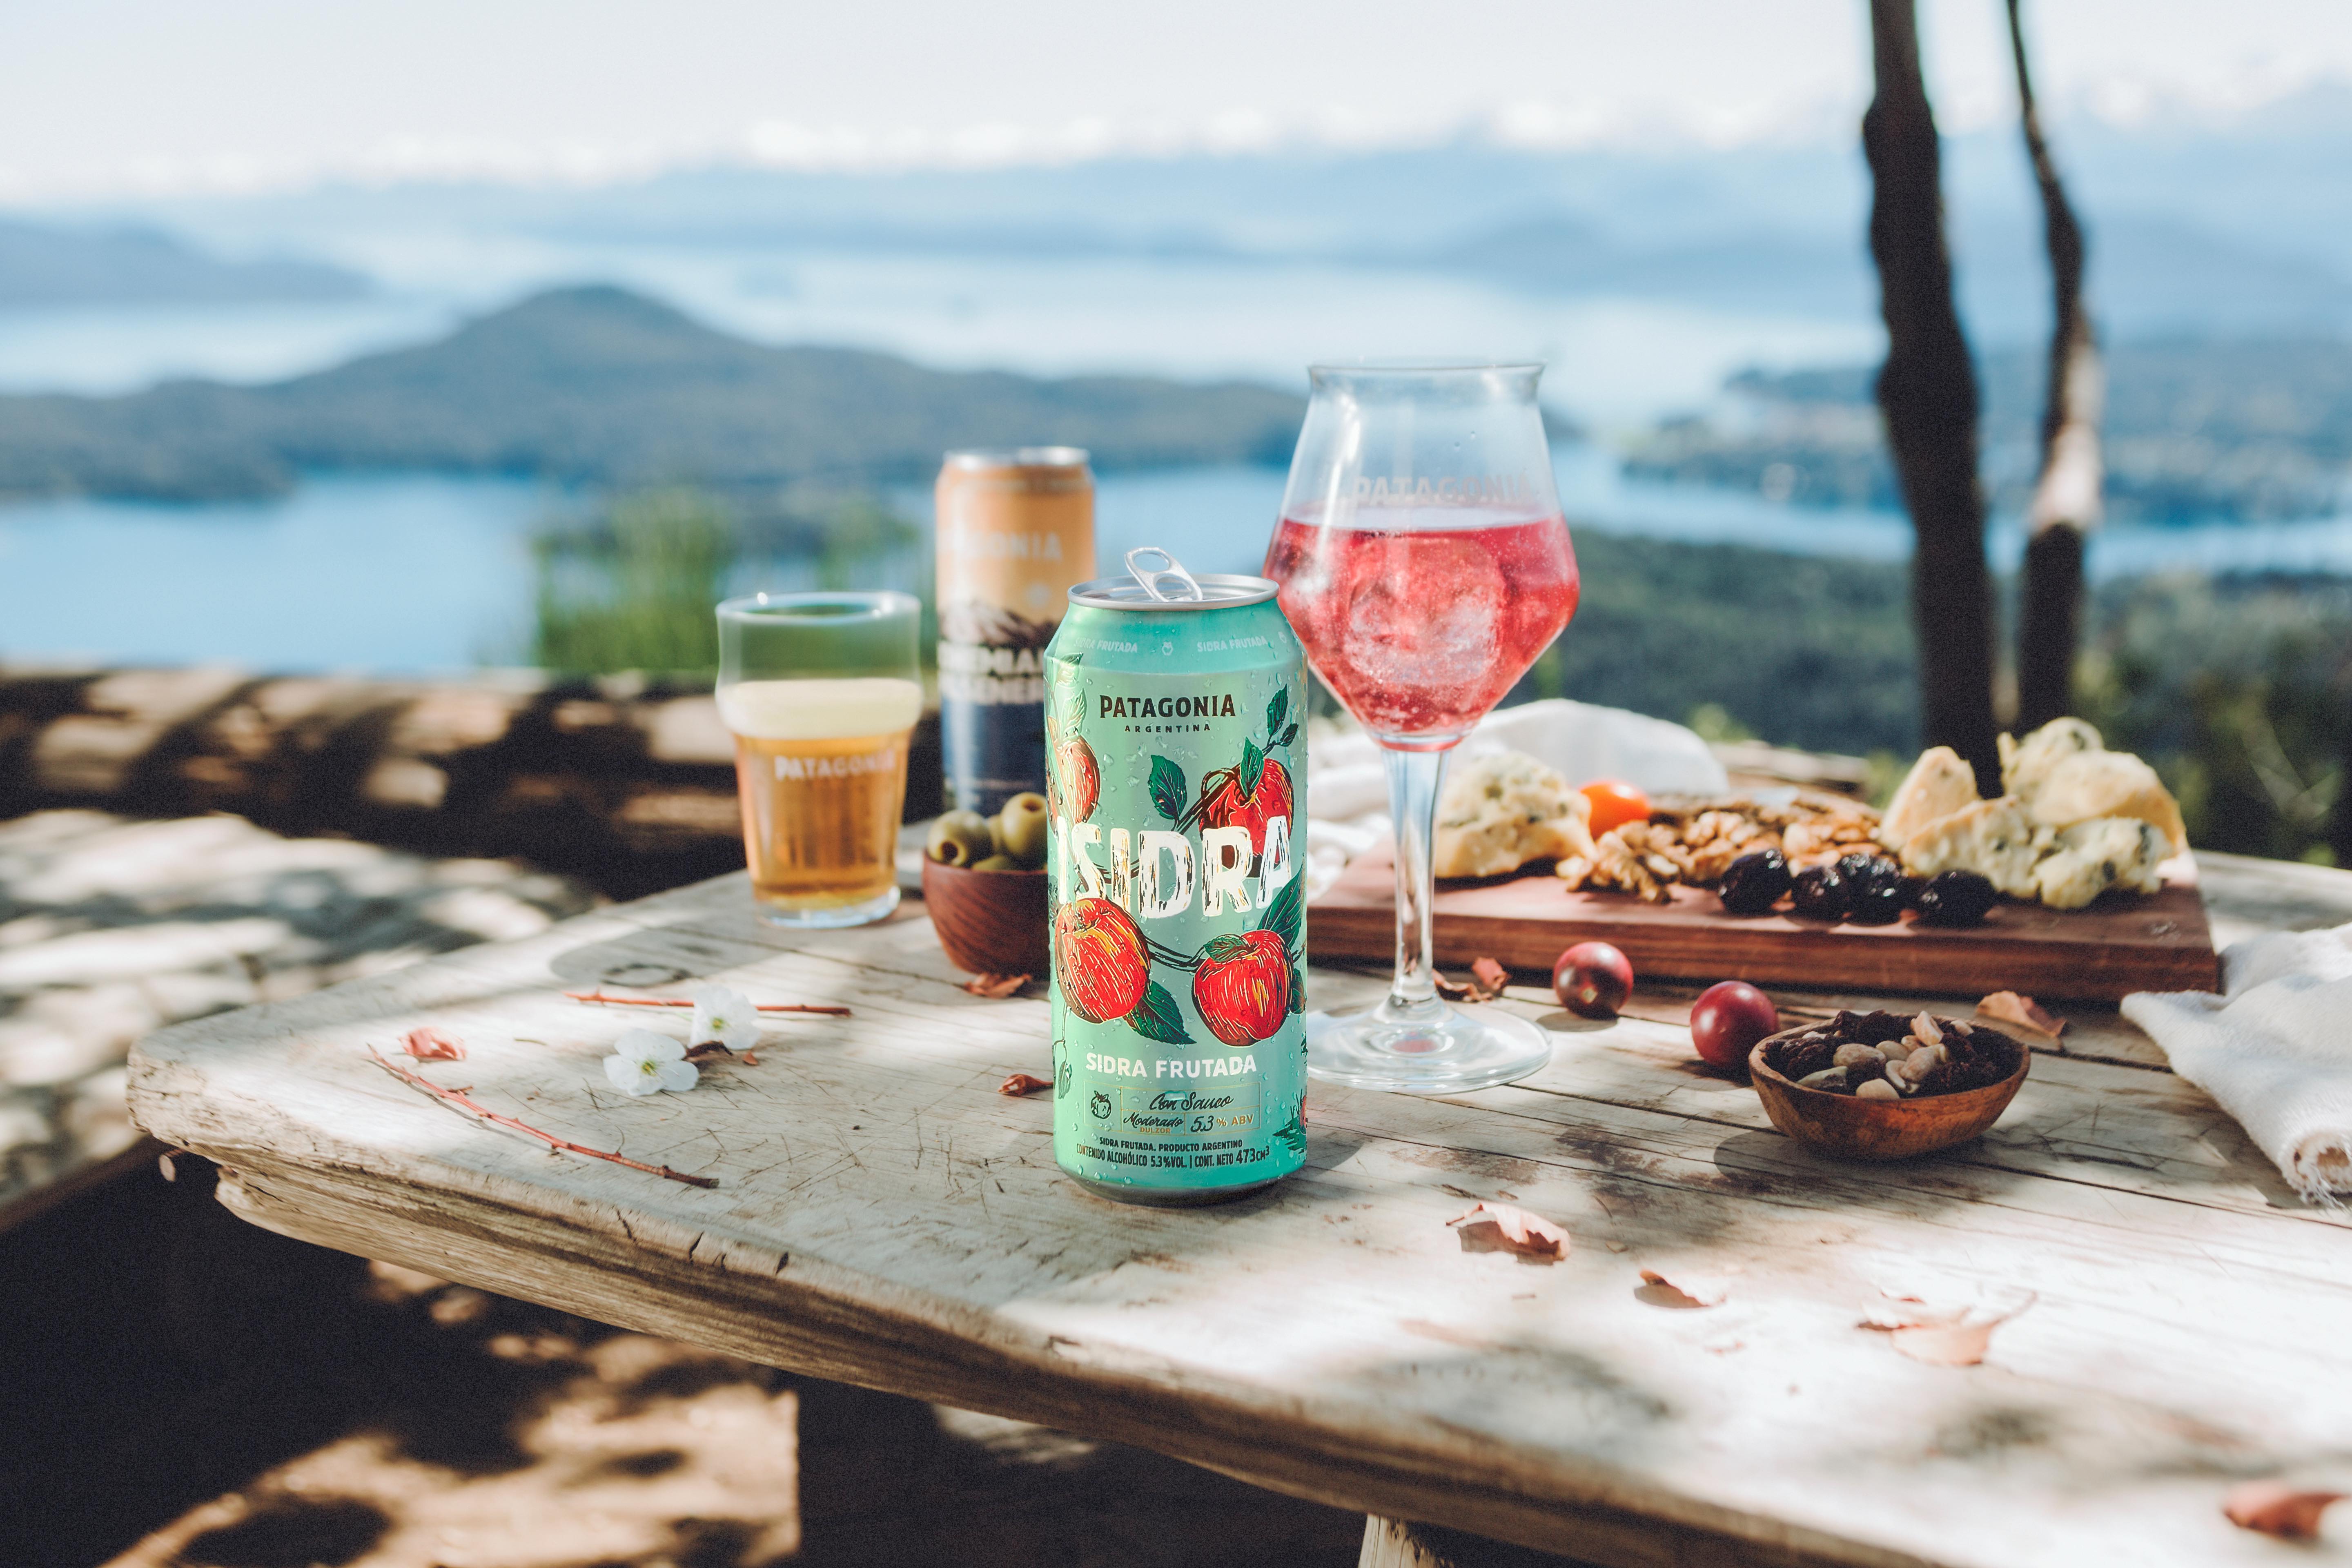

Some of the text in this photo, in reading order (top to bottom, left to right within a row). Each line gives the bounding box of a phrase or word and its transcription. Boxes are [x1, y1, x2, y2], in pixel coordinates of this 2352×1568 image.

[1352, 472, 1537, 506] PATAGONIA
[1074, 637, 1138, 653] SIDRA FRUTADA
[1196, 635, 1268, 652] SIDRA FRUTADA
[1100, 694, 1236, 719] PATAGONIA
[1125, 724, 1211, 733] ARGENTINA
[1085, 1051, 1257, 1078] SIDRA FRUTADA
[1149, 1091, 1234, 1111] Con Sauco
[1123, 1111, 1184, 1129] Moderado
[1190, 1115, 1214, 1133] 5.3
[1231, 1113, 1255, 1127] ABV
[1099, 1137, 1243, 1152] SIDRA FRUTADA. PRODUCTO ARGENTINO
[1076, 1143, 1106, 1161] CONTENIDO
[1107, 1151, 1148, 1167] ALCOHÓLICO
[1194, 1155, 1215, 1167] CONT.
[1216, 1152, 1234, 1166] NETO
